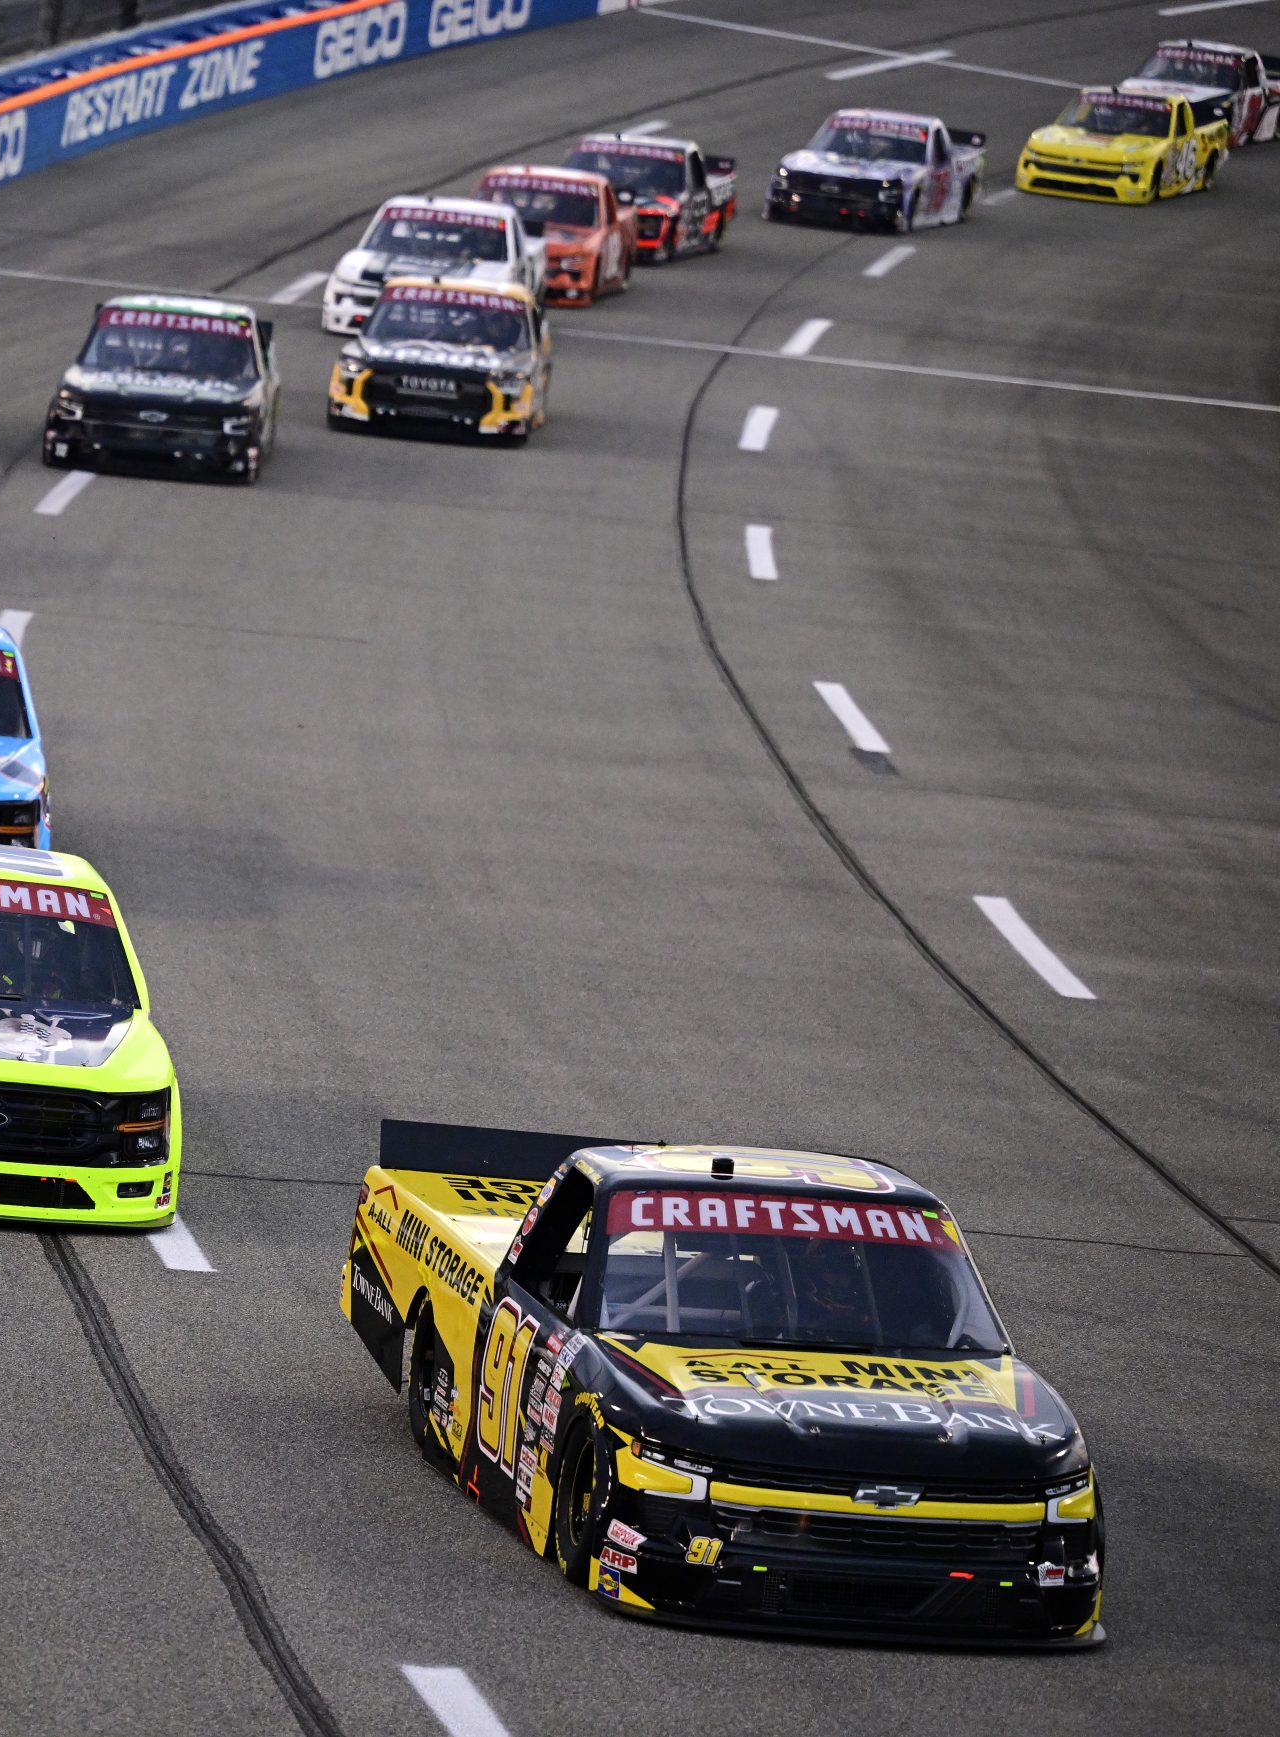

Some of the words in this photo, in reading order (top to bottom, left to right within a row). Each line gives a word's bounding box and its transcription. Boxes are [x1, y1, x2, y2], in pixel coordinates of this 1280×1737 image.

[60, 66, 175, 147] RESTART
[179, 40, 265, 110] ZONE
[314, 1, 407, 79] GEICO
[389, 209, 499, 228] CRAFTSMAN
[391, 287, 516, 312] CRAFTSMAN
[108, 311, 240, 336] CRAFTSMAN
[400, 375, 456, 392] TOYOTA
[630, 1196, 933, 1244] CRAFTSMAN
[368, 1202, 393, 1236] A-ALL
[396, 1209, 431, 1262] MINI
[424, 1236, 485, 1307] STORAGE
[684, 1359, 817, 1372] A-ALL
[839, 1359, 976, 1384] MINI
[690, 1368, 996, 1400] STORAGE
[477, 1295, 542, 1481] 91
[574, 1391, 606, 1430] GOODYEAR
[601, 1548, 637, 1570] ARP
[685, 1535, 724, 1567] 91
